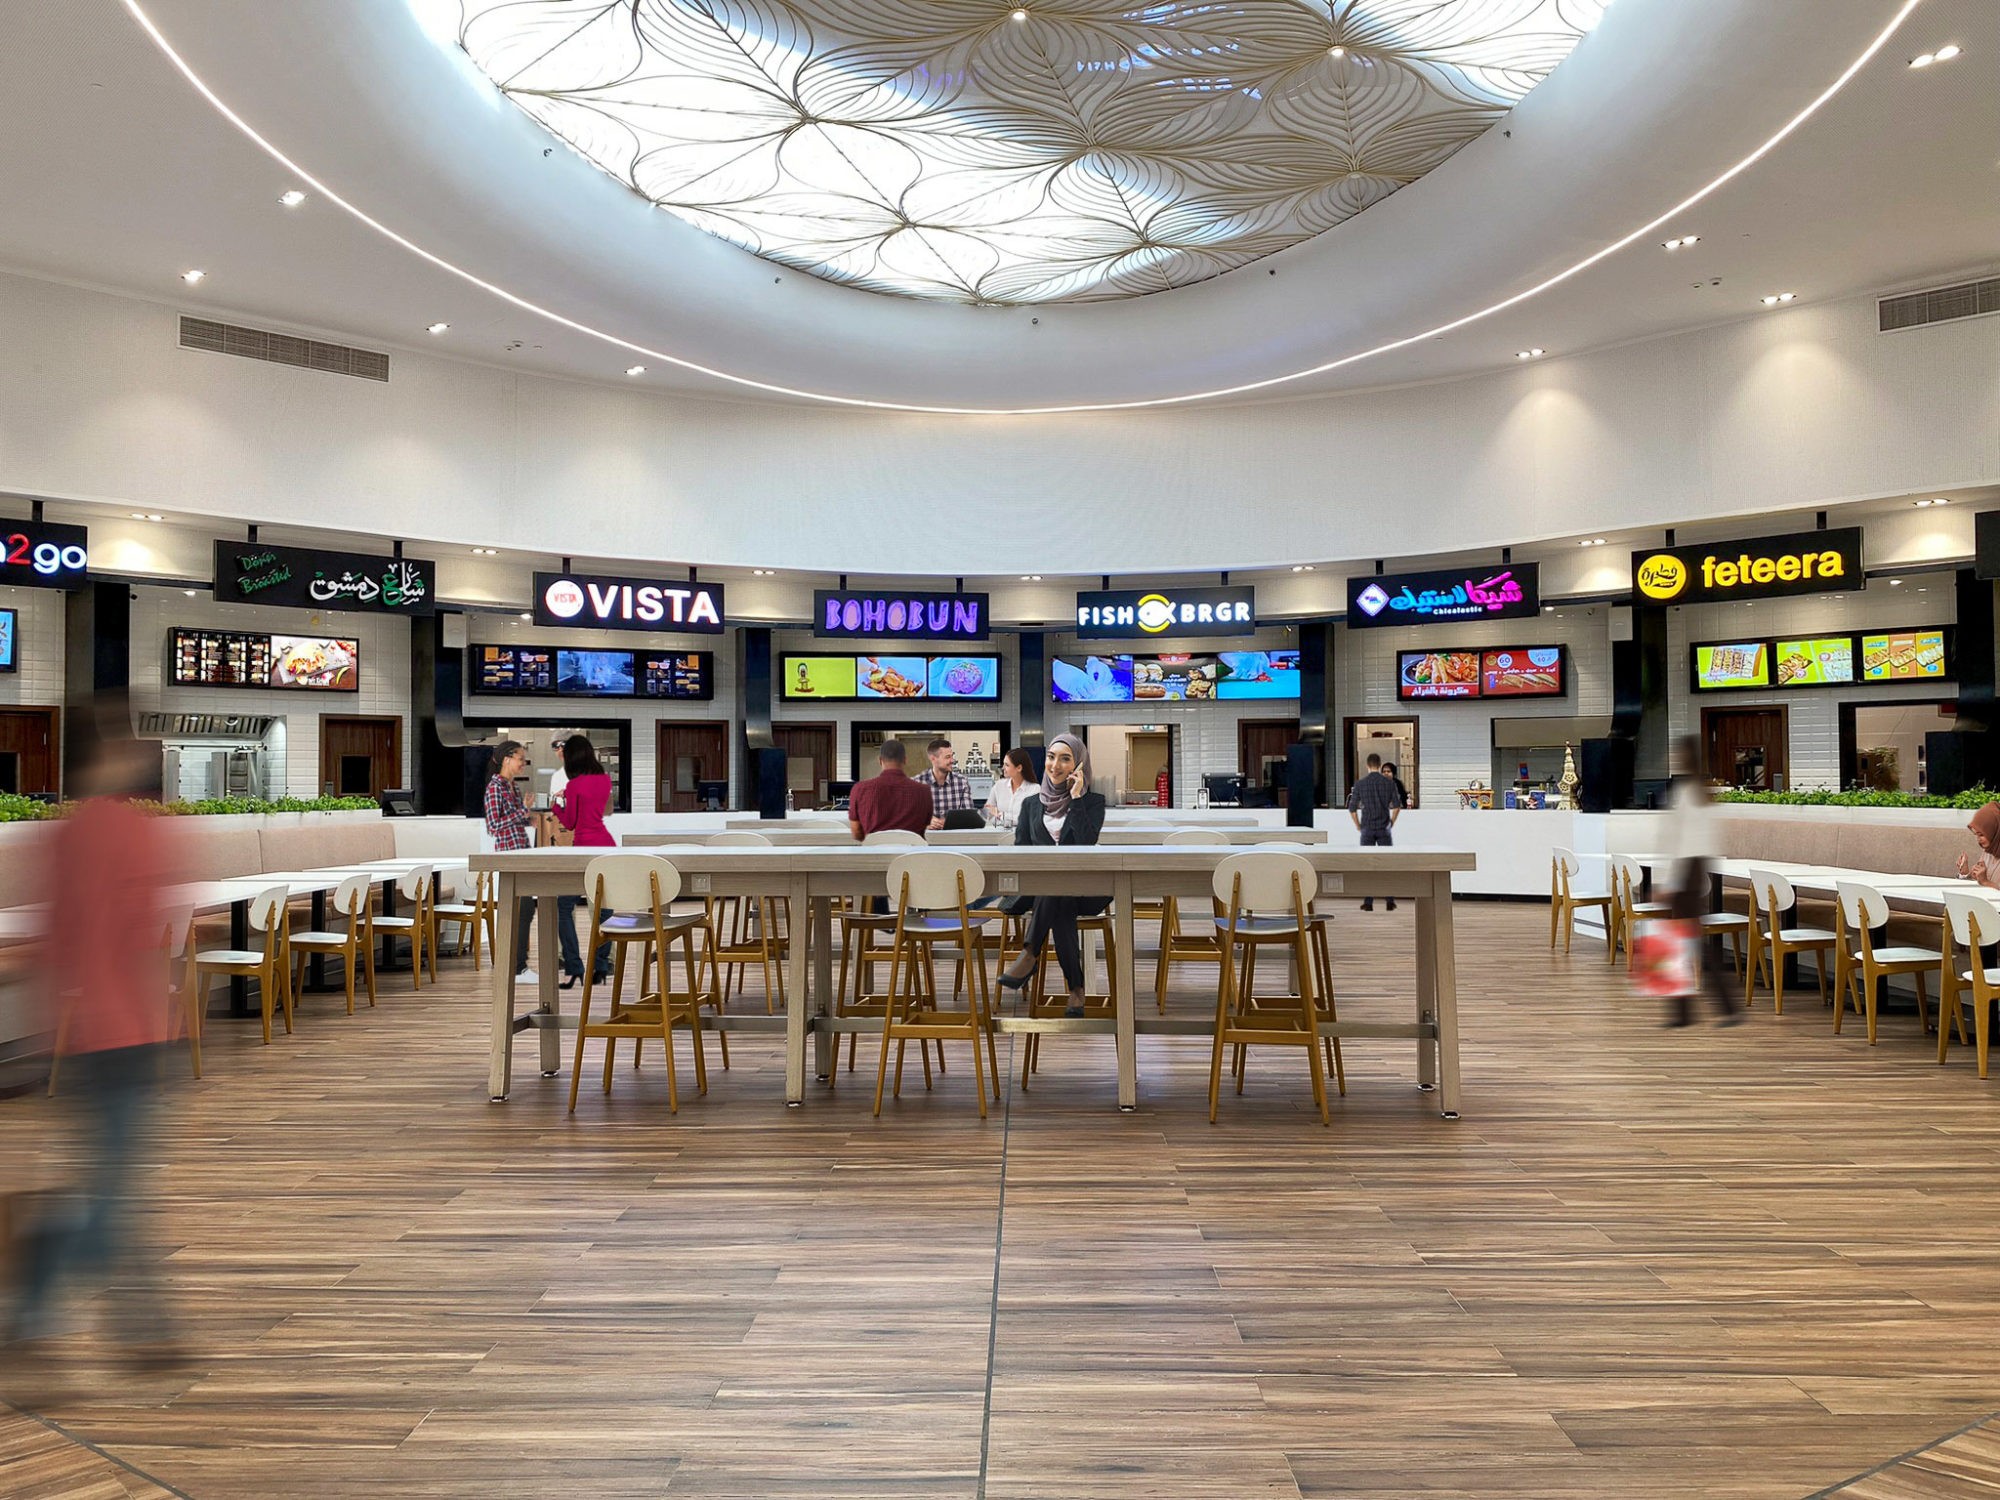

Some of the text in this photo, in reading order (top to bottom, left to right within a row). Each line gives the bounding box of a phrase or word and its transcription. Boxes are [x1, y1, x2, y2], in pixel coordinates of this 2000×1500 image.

[1704, 553, 1844, 587] feteera
[587, 584, 720, 624] VISTA
[826, 599, 978, 633] BOHOBUN
[1078, 603, 1251, 626] FISH BRGR
